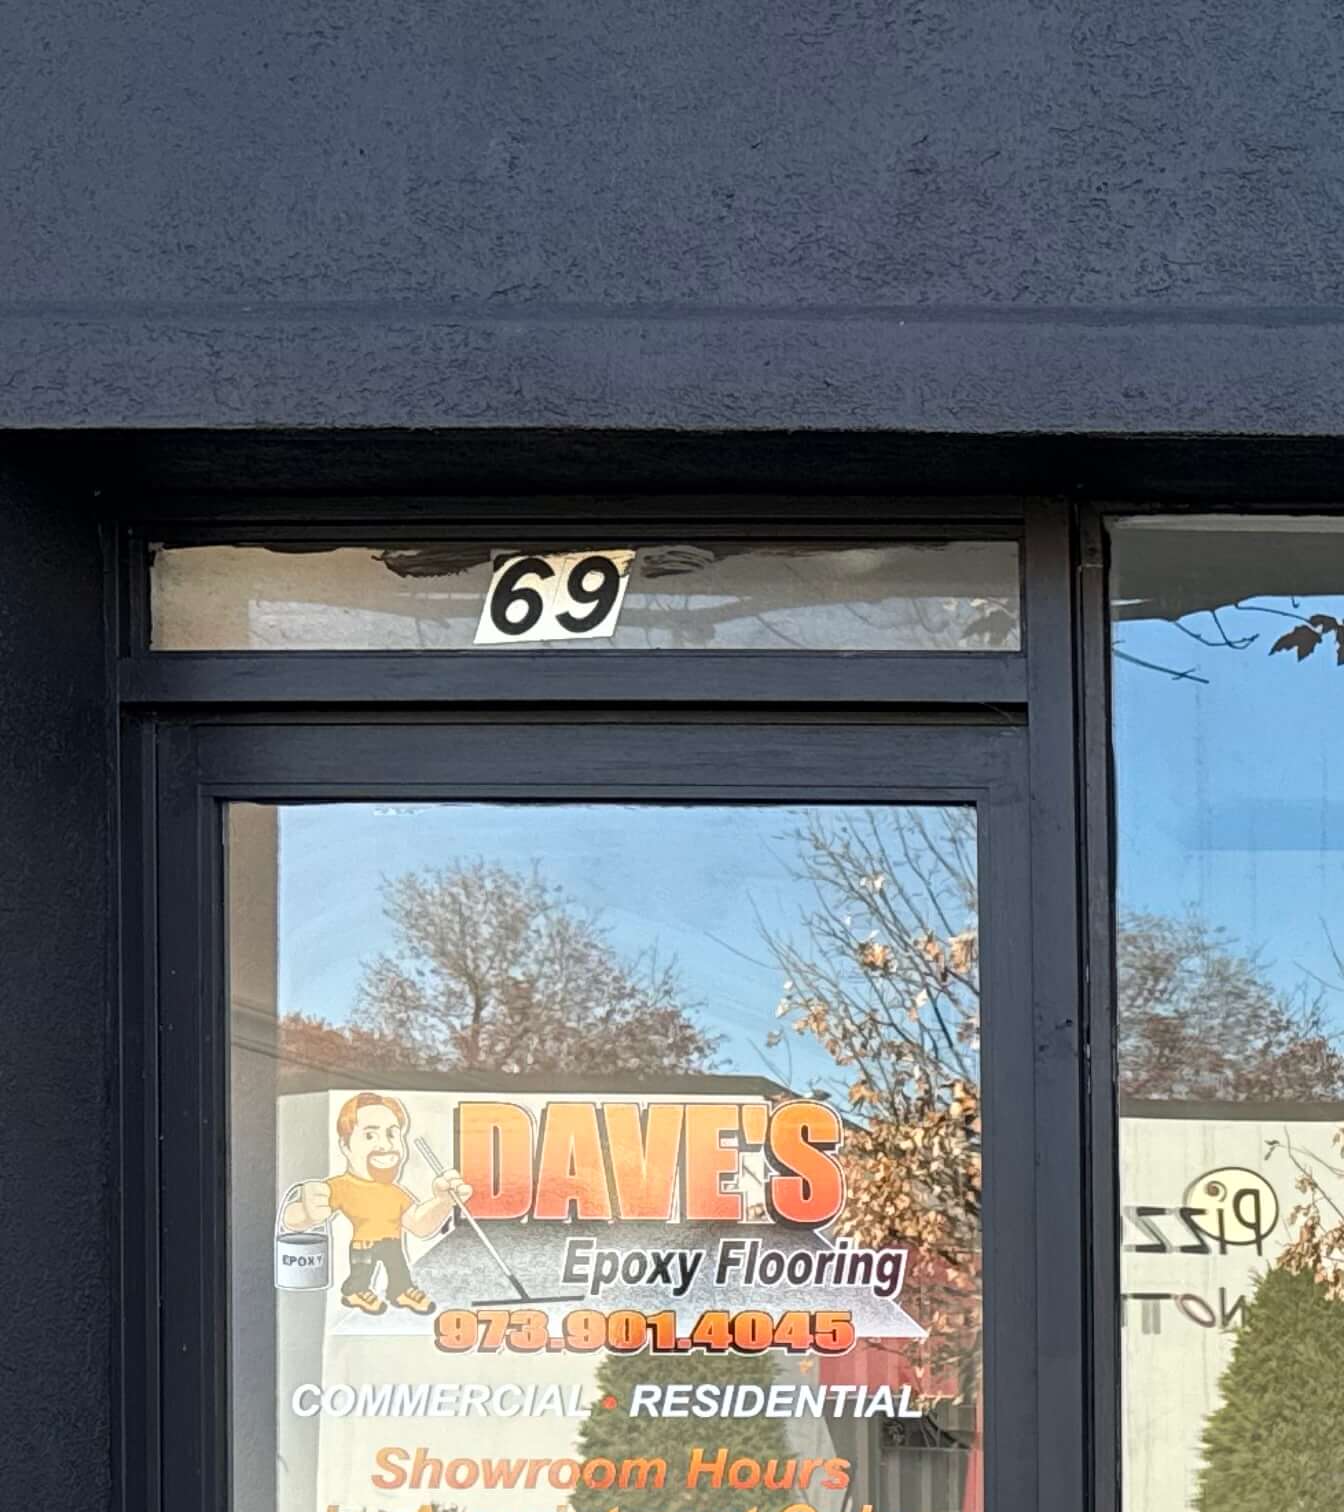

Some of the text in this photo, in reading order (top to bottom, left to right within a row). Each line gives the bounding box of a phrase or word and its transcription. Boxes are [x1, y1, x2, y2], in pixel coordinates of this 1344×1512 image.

[490, 555, 620, 635] 69
[453, 1100, 846, 1228] DAVE'S
[282, 1254, 323, 1267] EPOXY
[561, 1238, 907, 1295] Epoxy Flooring
[434, 1308, 858, 1356] 973.901.4045
[291, 1382, 924, 1419] COMMERCIAL RESIDENTIAL
[371, 1445, 851, 1491] Showroom Hours
